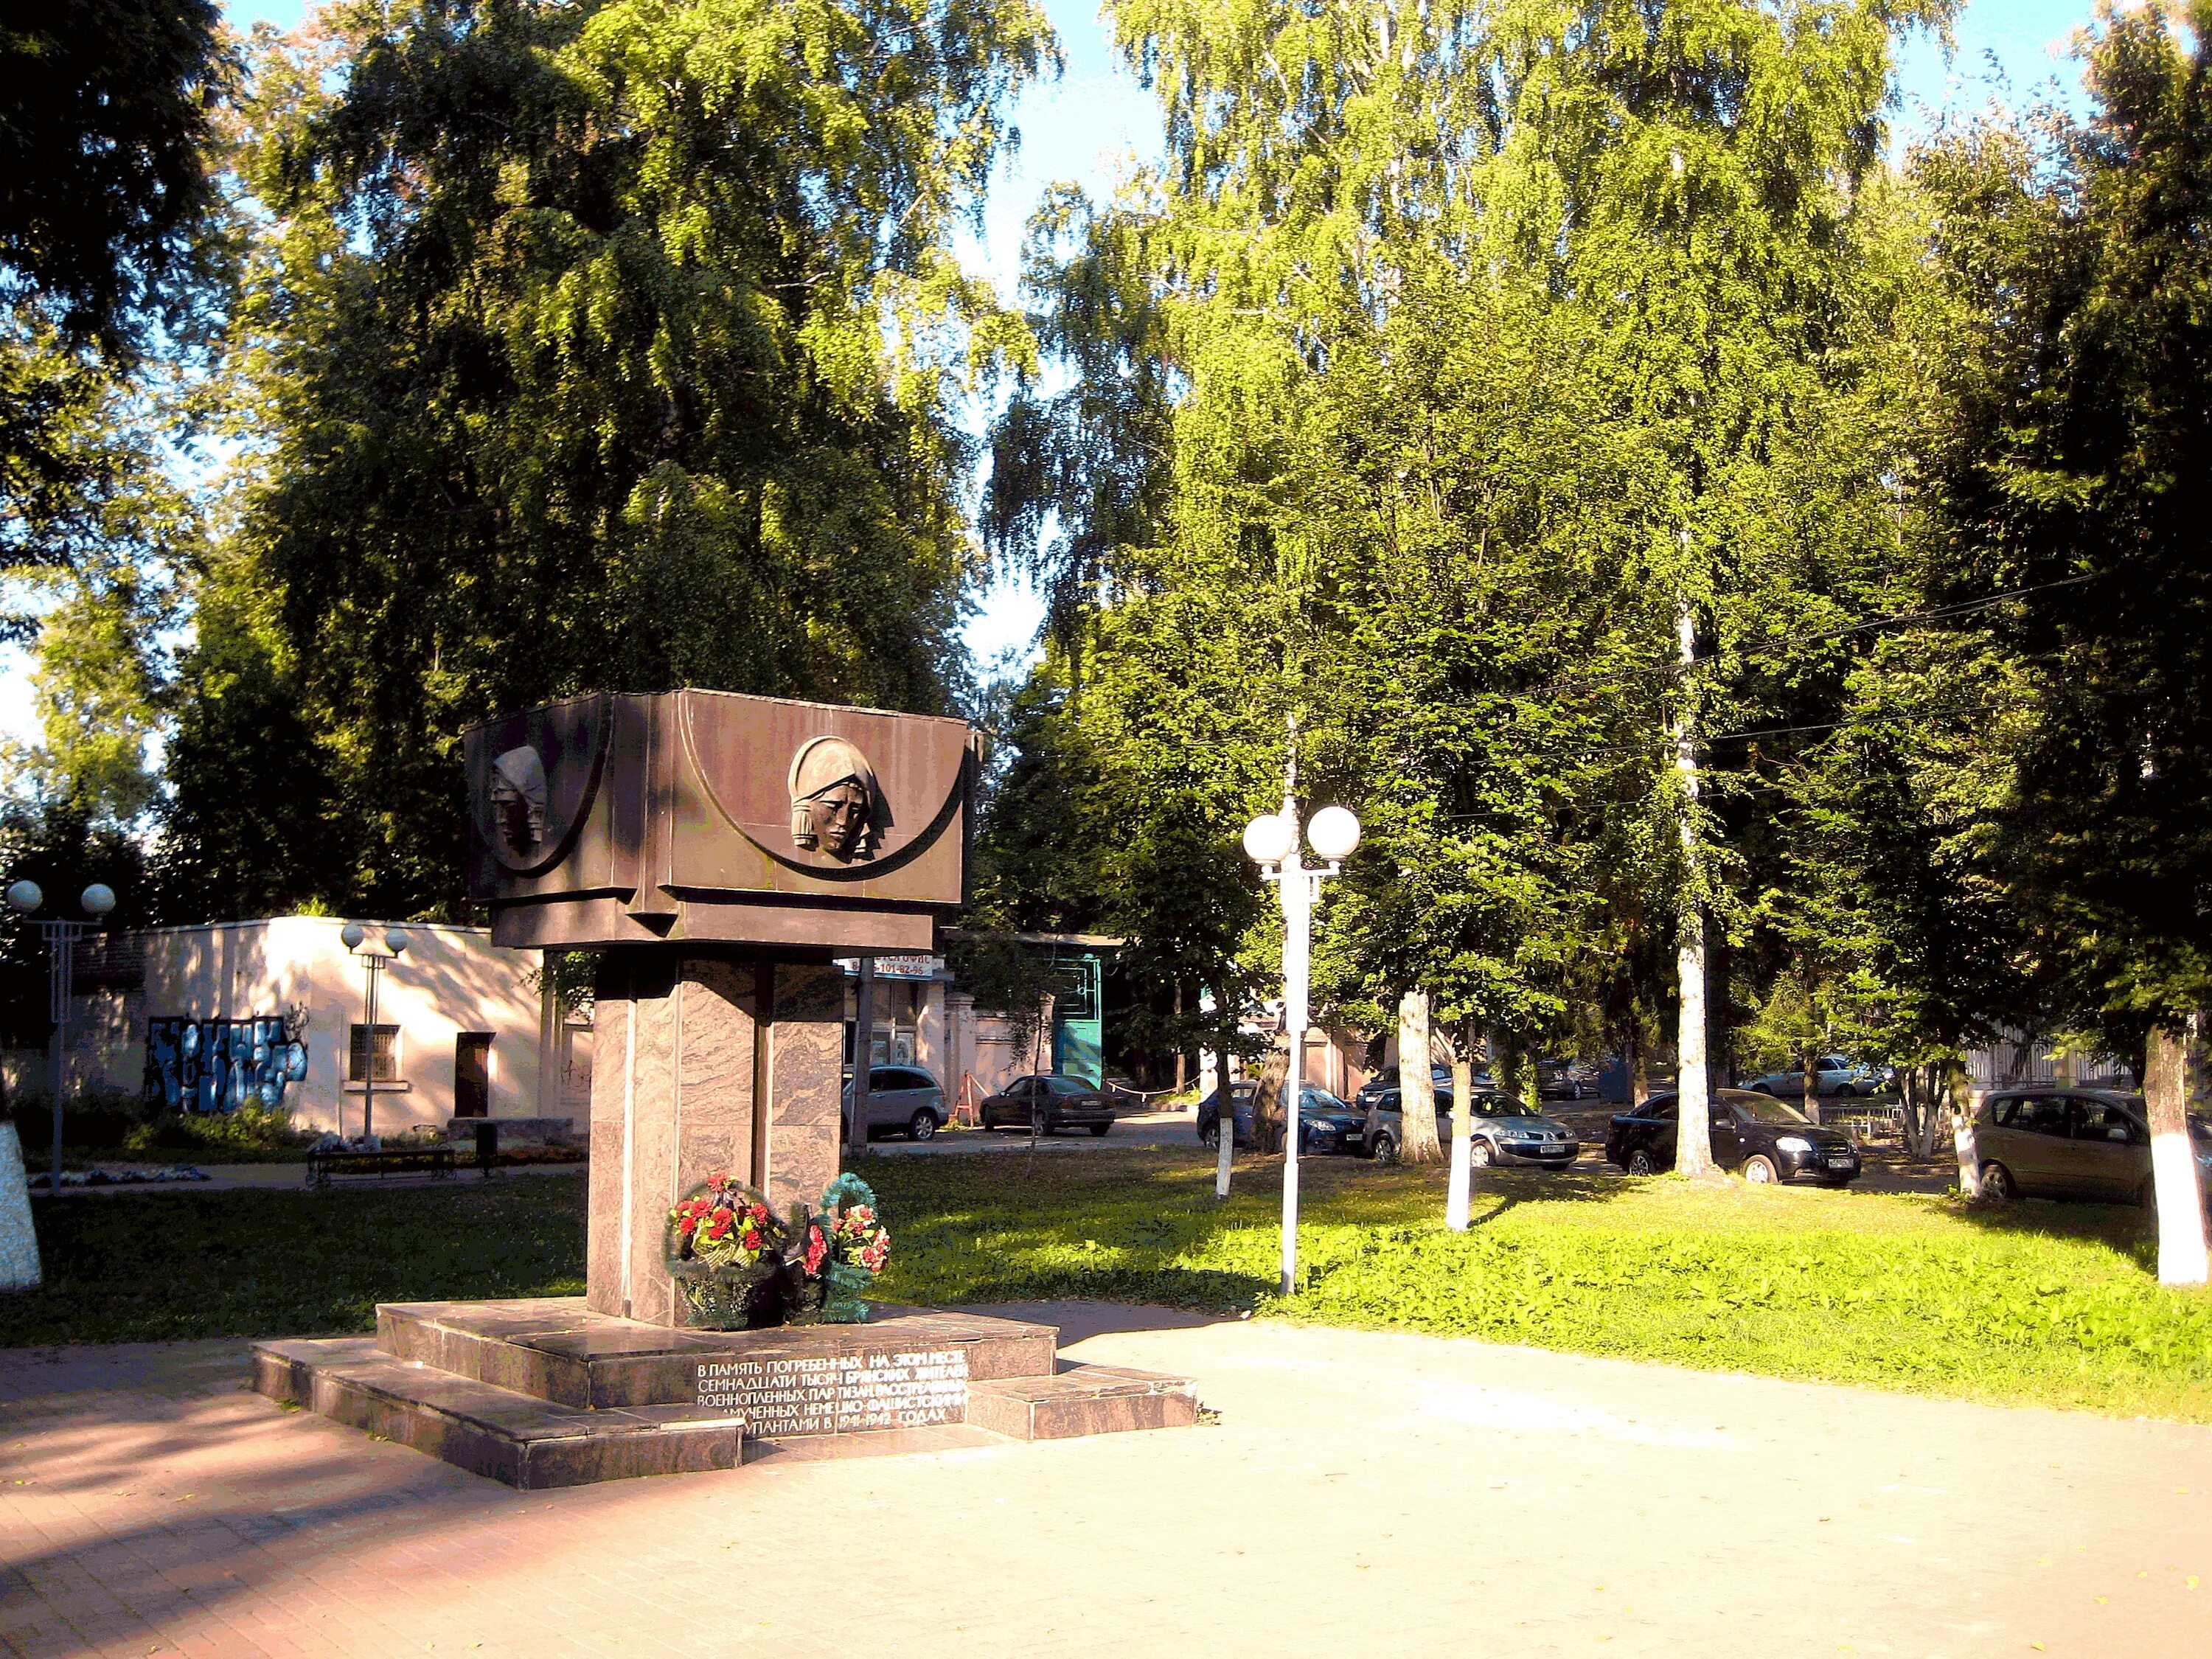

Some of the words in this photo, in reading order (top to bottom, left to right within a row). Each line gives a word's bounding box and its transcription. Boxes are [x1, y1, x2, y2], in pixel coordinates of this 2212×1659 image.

[698, 1365, 706, 1377] В
[709, 1362, 762, 1377] ПАМЯТЬ
[767, 1355, 863, 1374] ПОГРЕБЕННЫХ
[869, 1354, 890, 1368] НА
[893, 1352, 927, 1367] ЭТОМ
[930, 1349, 967, 1364] МЕСТЕ
[698, 1375, 796, 1392] СЕМНАДЦАТИ
[800, 1371, 843, 1387] ТЫСЯЧ
[846, 1369, 910, 1384] БРЯНСКИХ
[698, 1389, 808, 1407] ВОЕННОПЛЕННЫХ,
[723, 1404, 800, 1419] МУЧЕННЫХ
[745, 1417, 820, 1434] УПАНТАМИ
[824, 1416, 832, 1429] В
[898, 1408, 947, 1425] ГОДАХ
